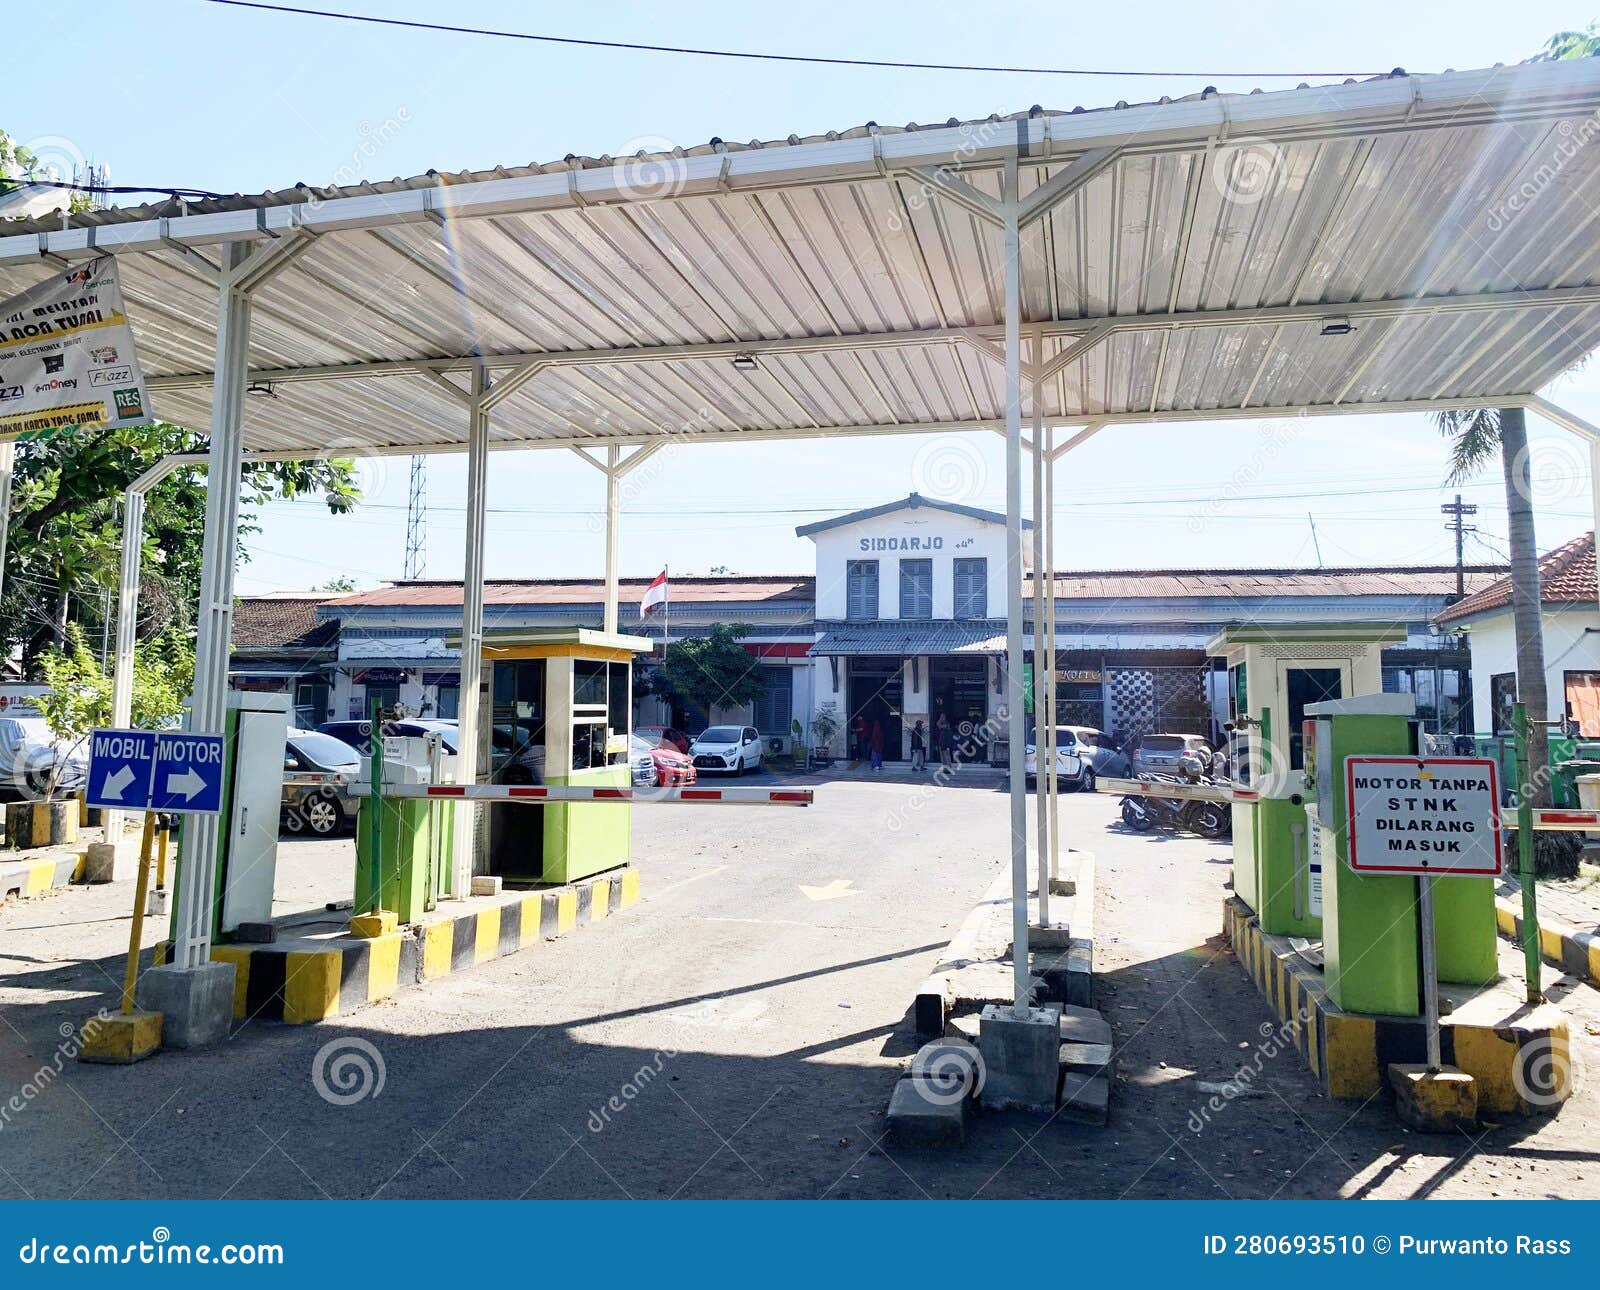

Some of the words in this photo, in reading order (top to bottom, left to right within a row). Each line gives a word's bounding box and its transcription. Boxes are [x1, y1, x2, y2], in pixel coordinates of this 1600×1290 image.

[116, 392, 140, 407] RES
[860, 536, 943, 551] SIDOARJO
[94, 737, 150, 760] MOBIL
[158, 740, 221, 763] MOTOR
[1355, 778, 1422, 790] MOTOR
[1429, 778, 1490, 791] TANPA
[1388, 798, 1457, 812] STNK
[1376, 819, 1475, 832] DILARANG
[1389, 839, 1461, 853] MASUK
